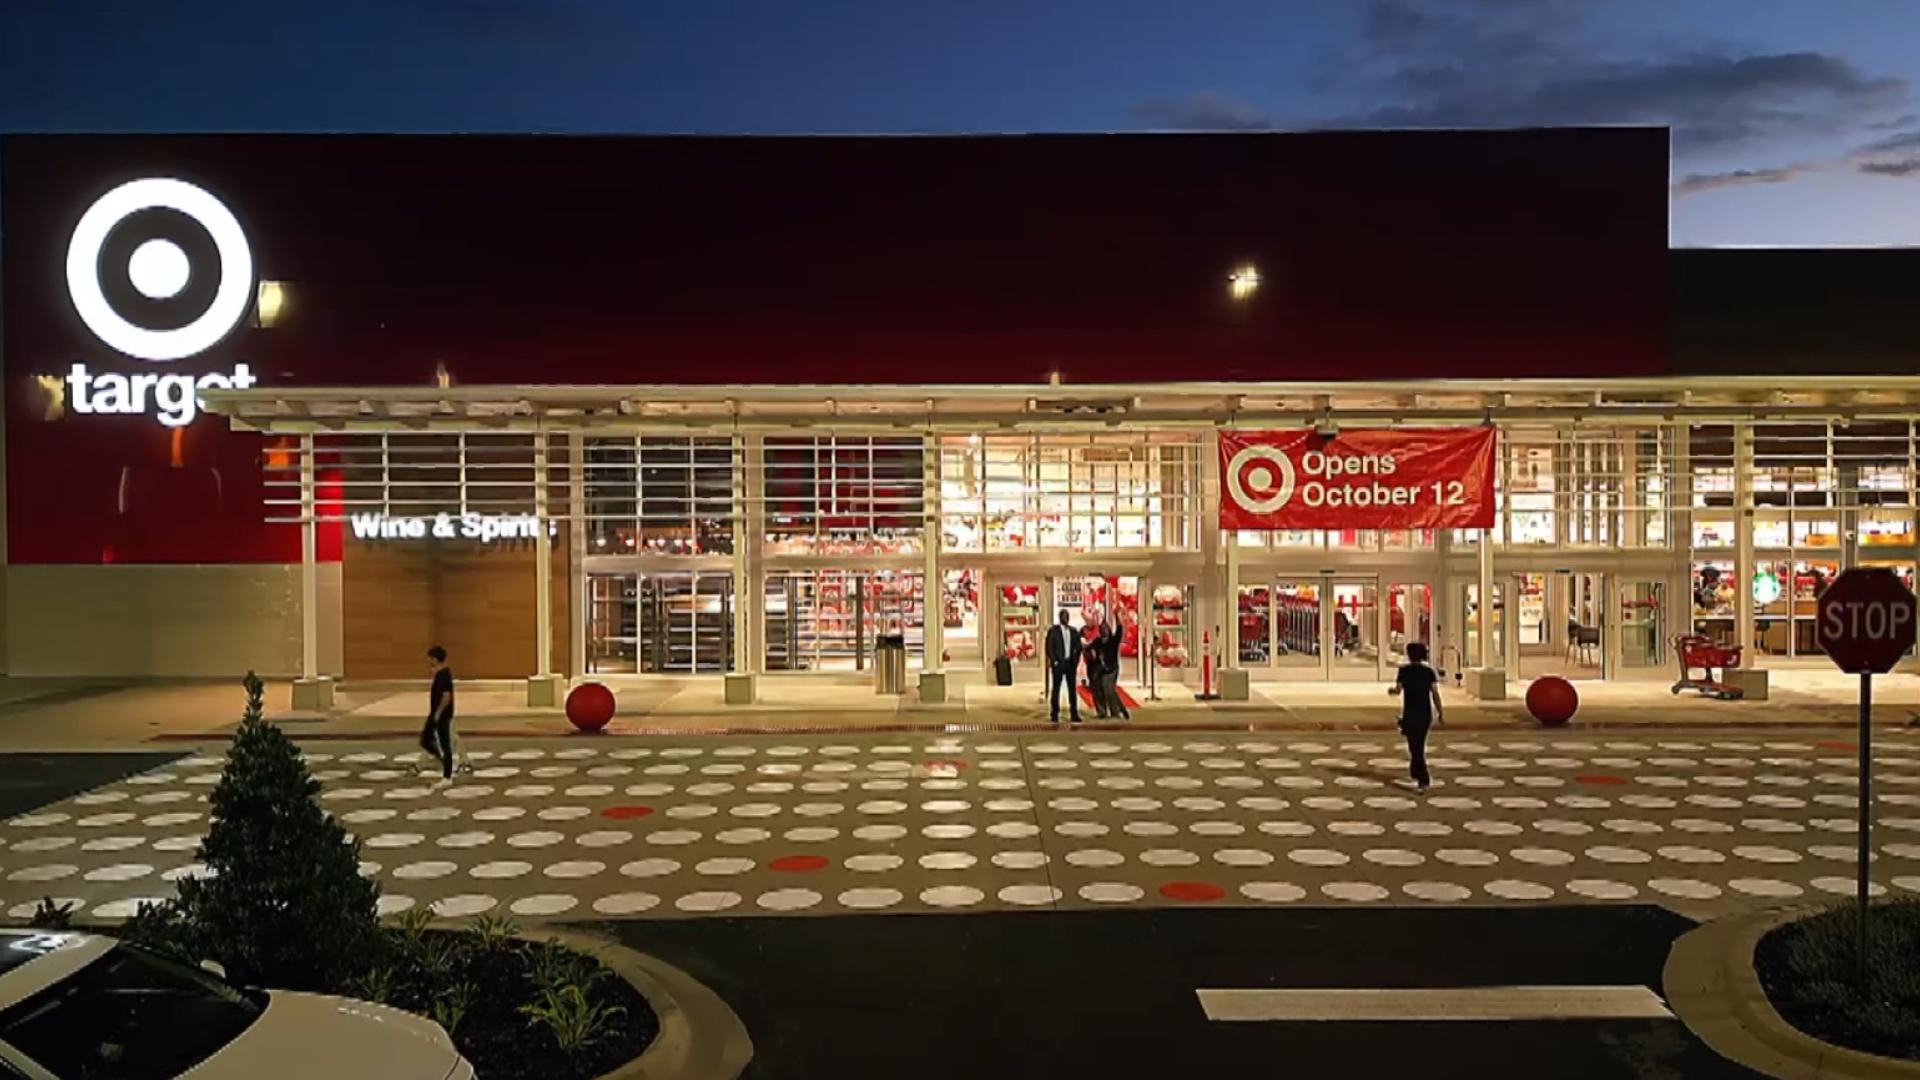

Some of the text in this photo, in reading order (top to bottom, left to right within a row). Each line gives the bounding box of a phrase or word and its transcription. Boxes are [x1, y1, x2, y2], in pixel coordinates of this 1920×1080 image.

[1302, 451, 1397, 480] Opens
[1302, 480, 1465, 507] October 12
[351, 511, 425, 538] Wine
[432, 511, 455, 538] &
[1824, 601, 1911, 639] STOP
